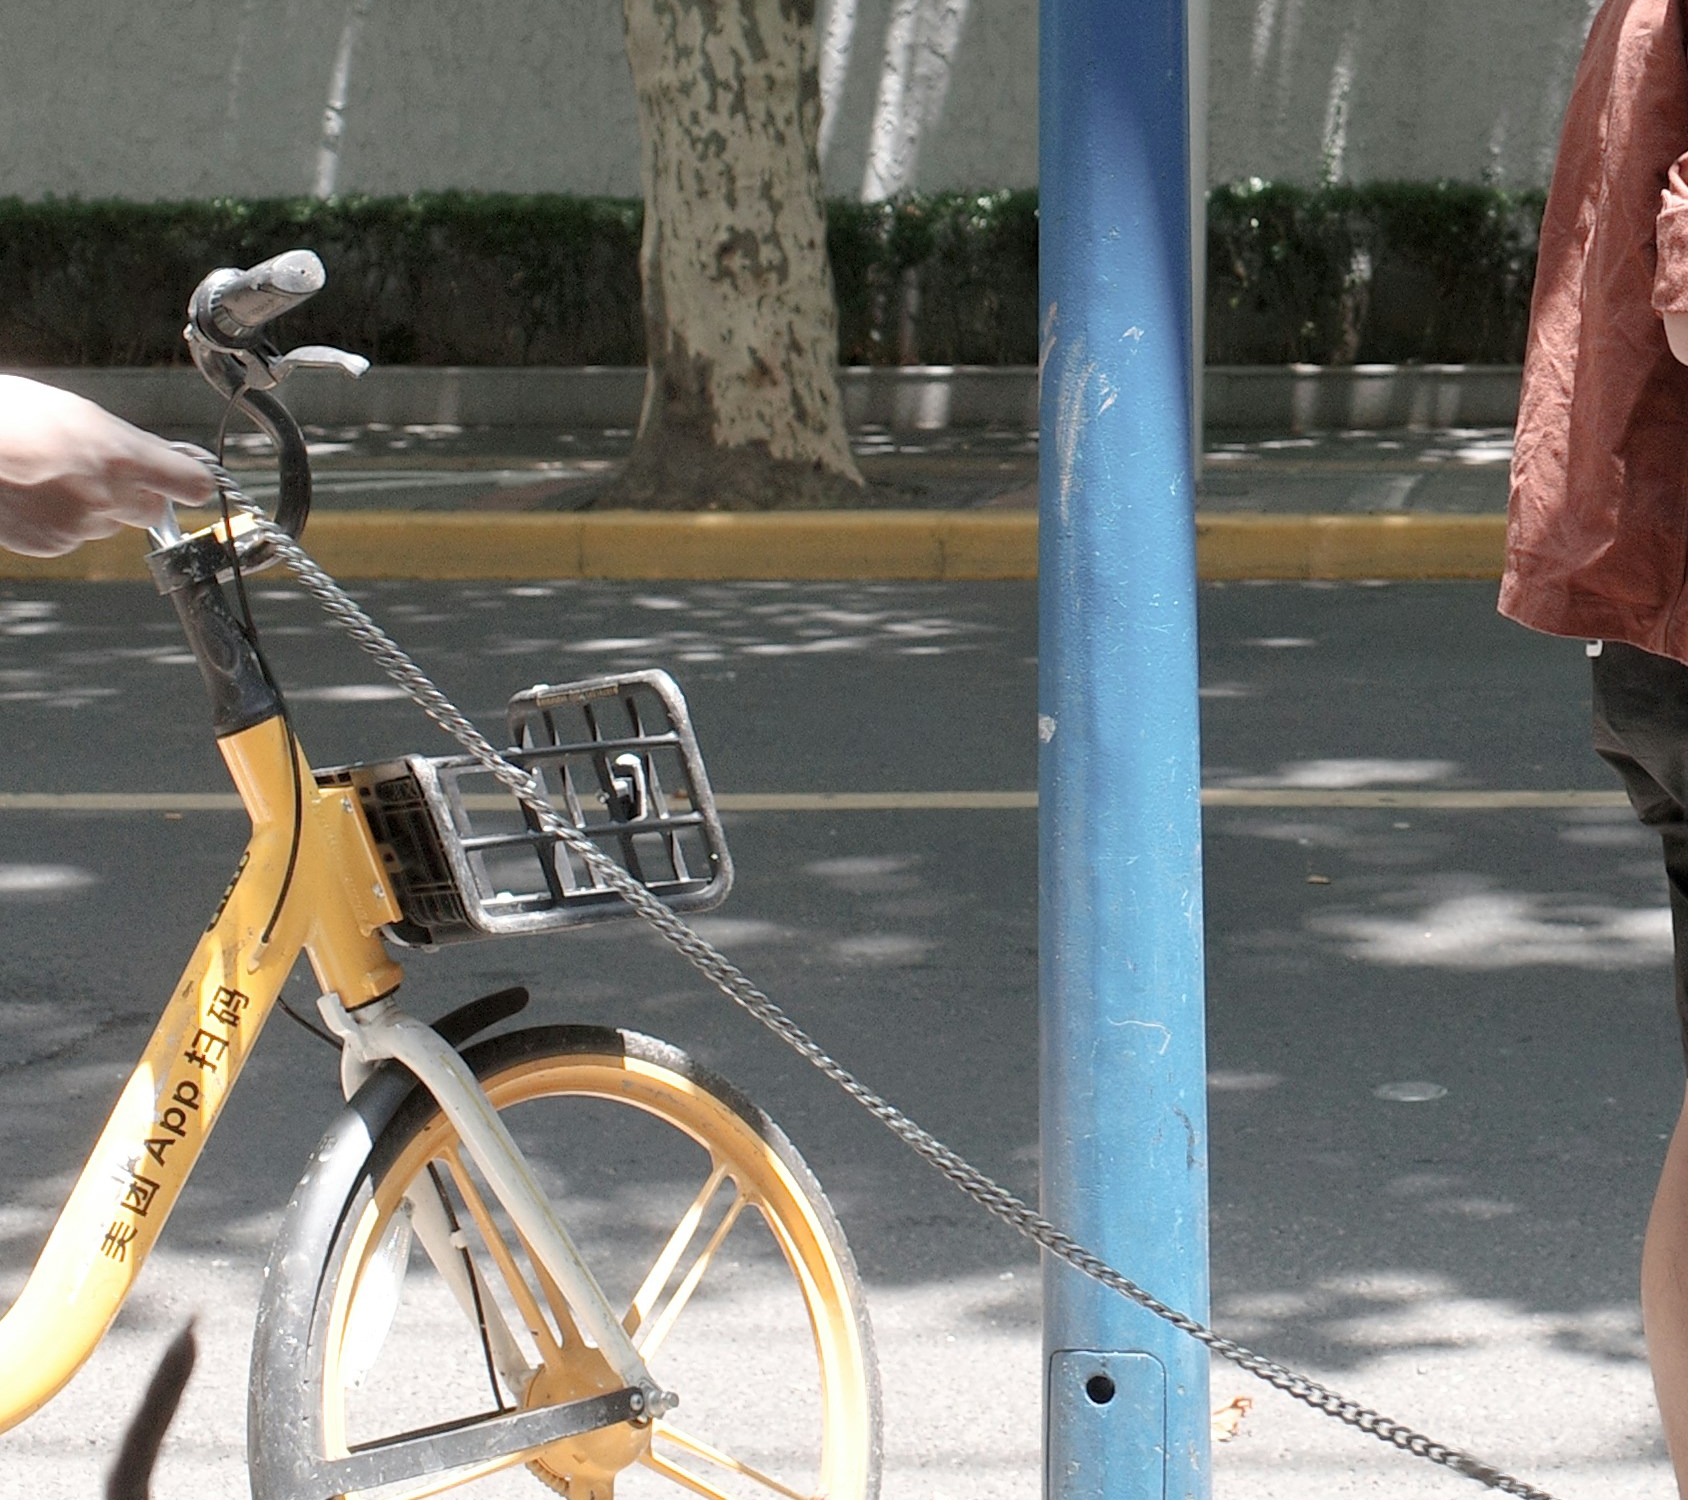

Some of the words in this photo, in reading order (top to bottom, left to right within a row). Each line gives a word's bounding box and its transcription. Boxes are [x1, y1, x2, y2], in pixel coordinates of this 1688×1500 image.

[101, 1173, 160, 1263] 美团
[143, 1079, 200, 1167] App
[184, 985, 250, 1073] 扫码
